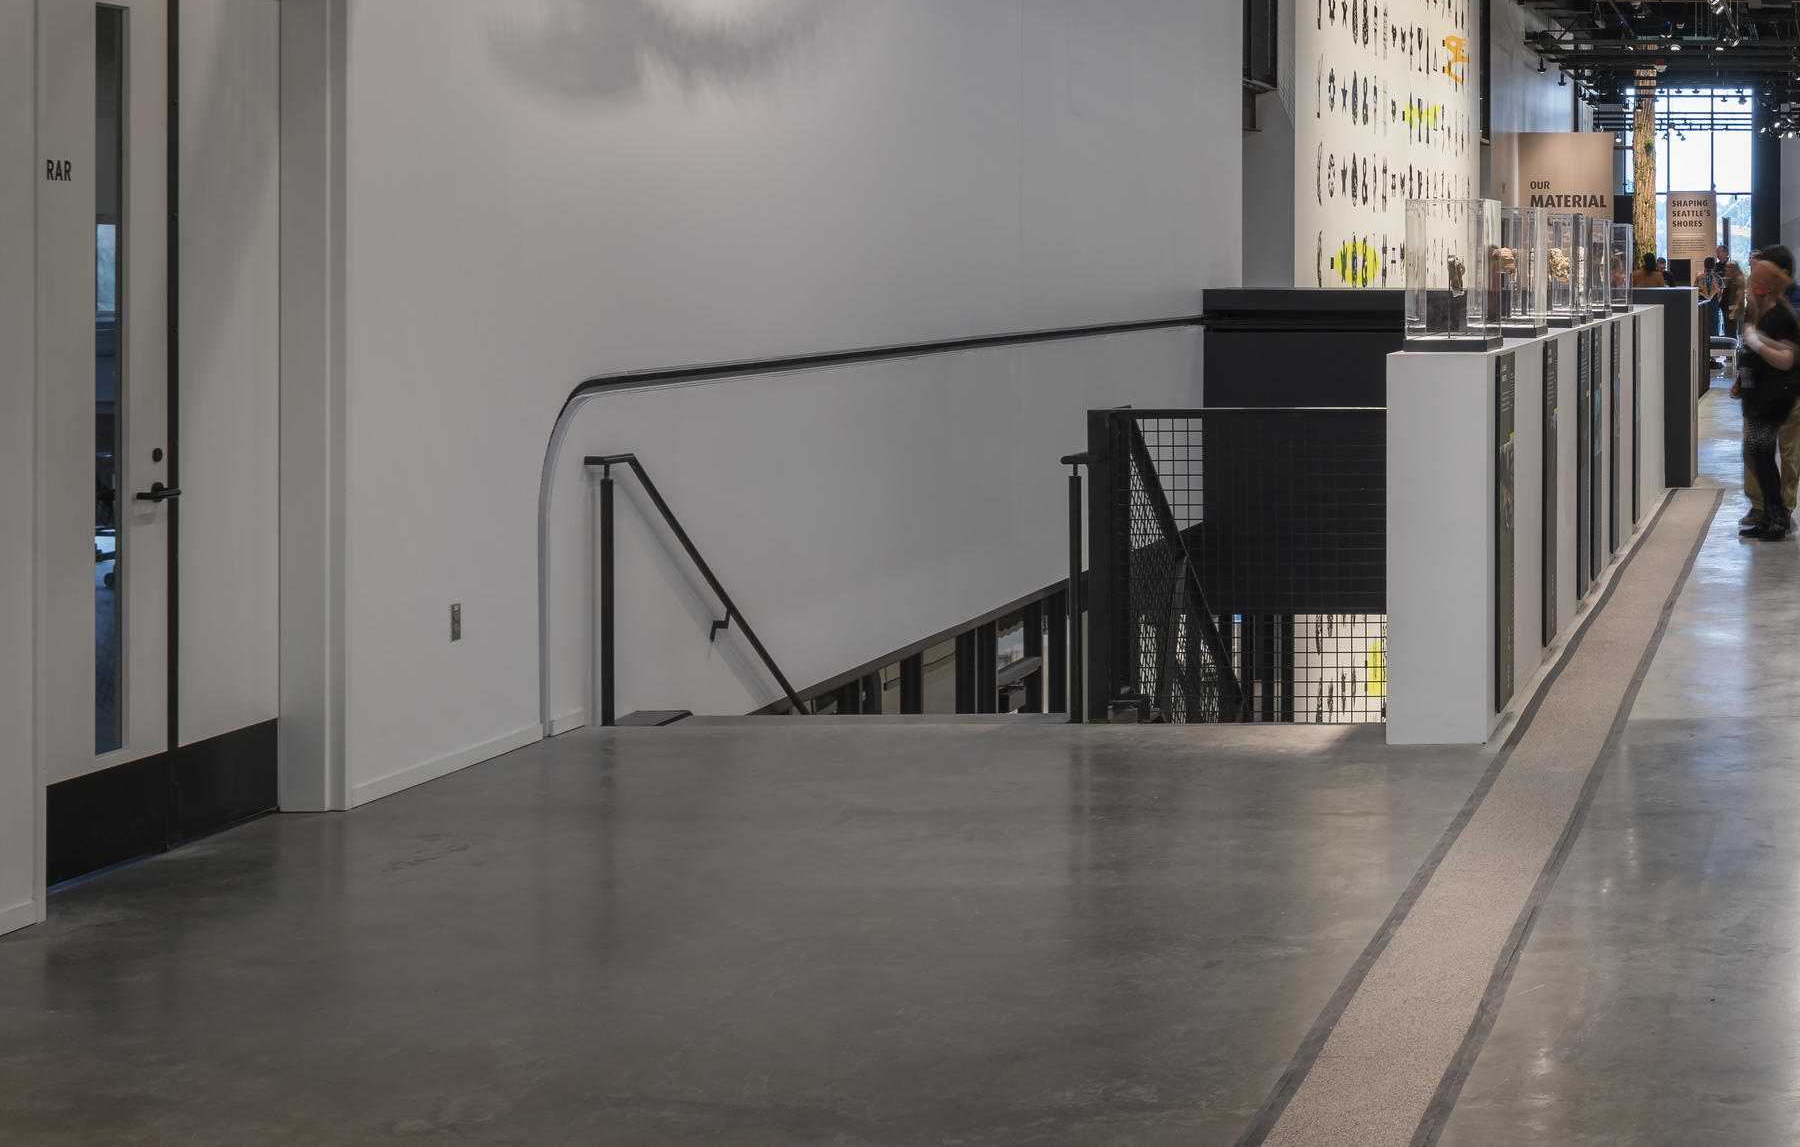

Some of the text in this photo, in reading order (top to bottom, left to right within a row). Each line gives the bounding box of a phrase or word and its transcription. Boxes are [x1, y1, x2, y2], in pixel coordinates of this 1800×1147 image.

[46, 159, 72, 181] RAR
[1530, 181, 1550, 190] OUR
[1530, 195, 1607, 208] MATERIAL
